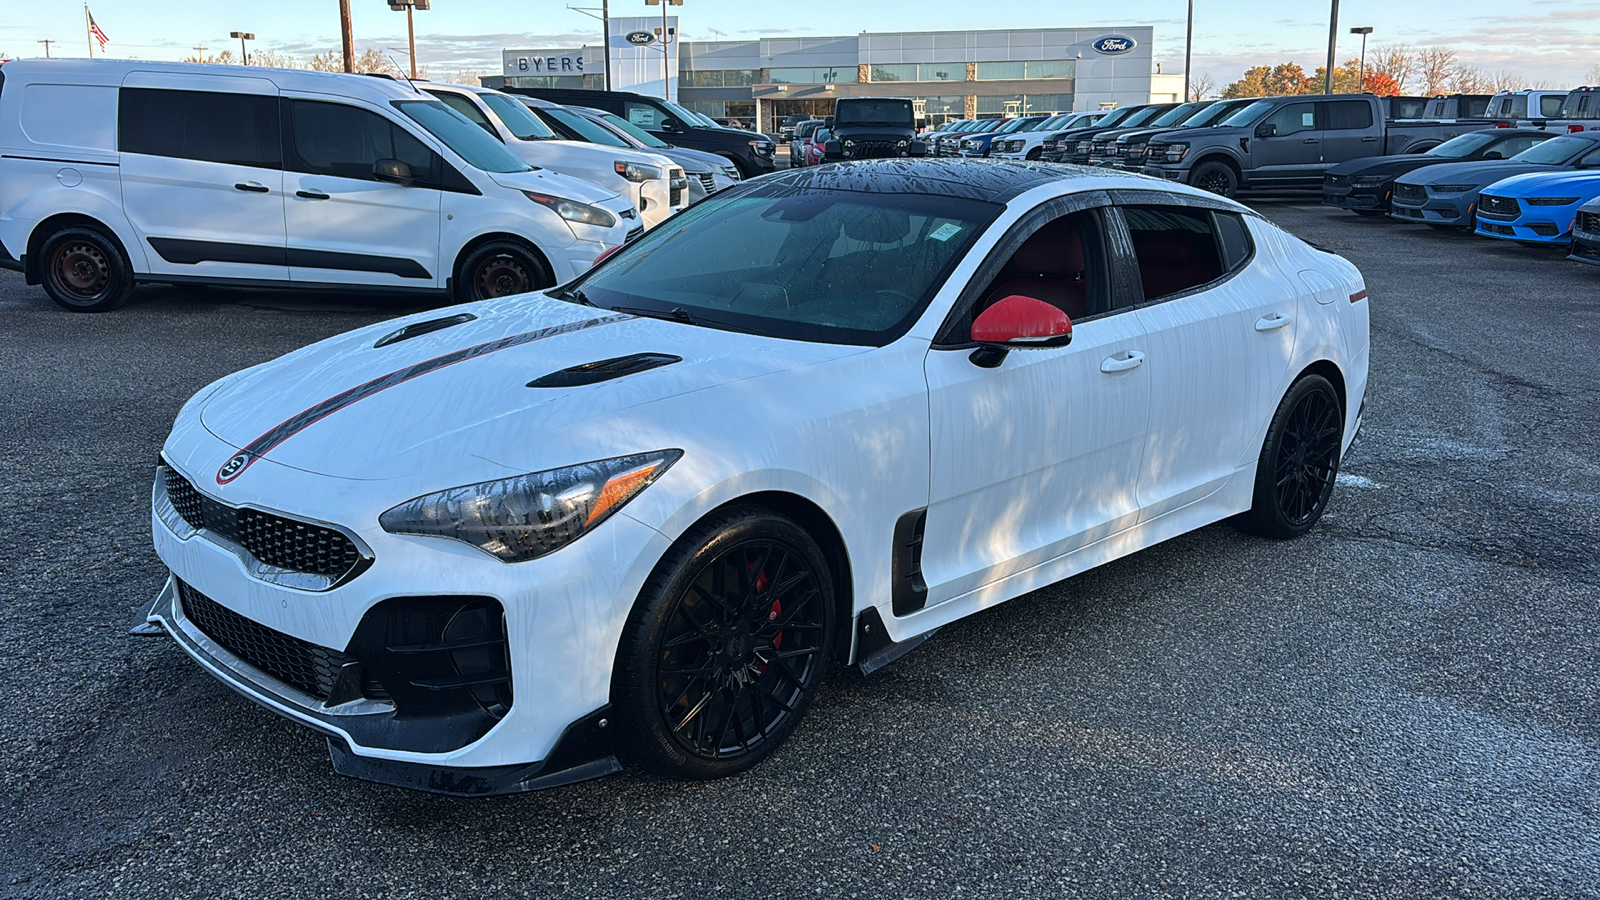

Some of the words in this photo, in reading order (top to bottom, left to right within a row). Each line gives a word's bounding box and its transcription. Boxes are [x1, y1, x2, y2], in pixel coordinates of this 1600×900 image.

[631, 33, 649, 43] Ford
[1101, 39, 1128, 50] Ford
[518, 57, 584, 71] BYERS
